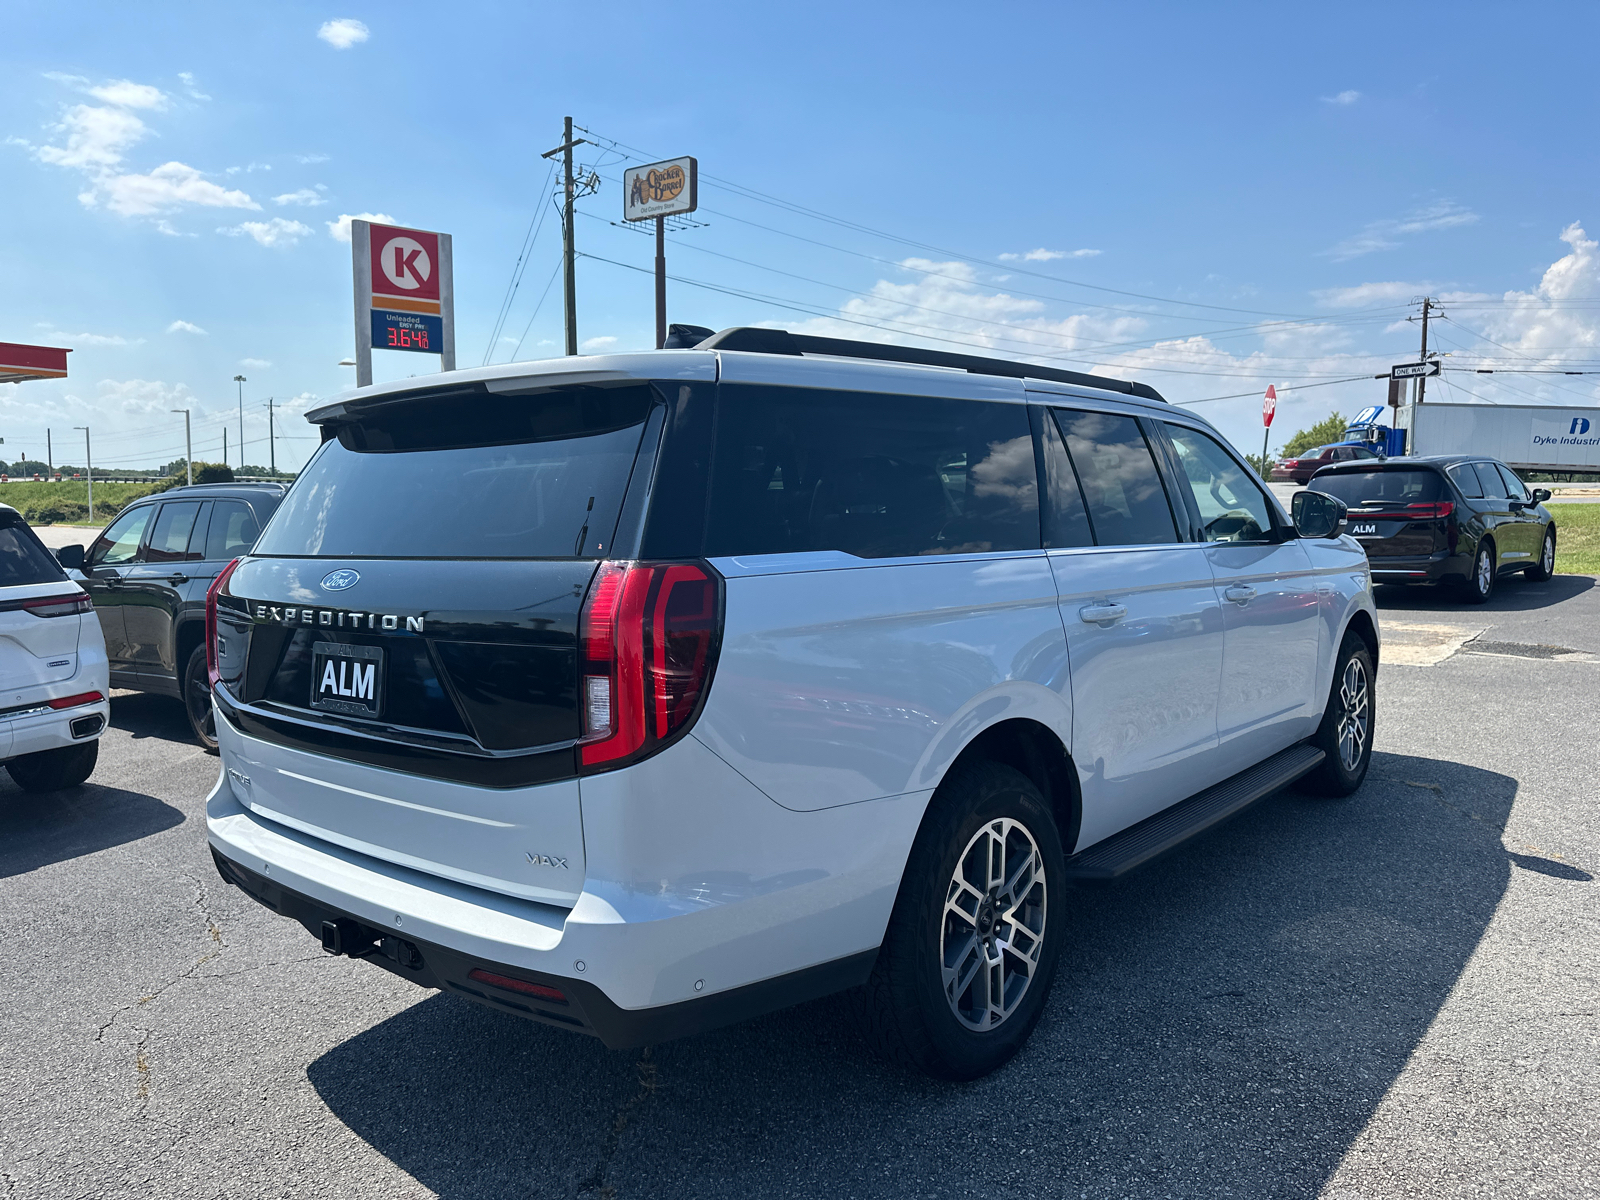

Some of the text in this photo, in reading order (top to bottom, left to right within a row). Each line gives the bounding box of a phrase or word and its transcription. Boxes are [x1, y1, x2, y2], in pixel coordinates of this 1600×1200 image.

[647, 170, 680, 188] Cracker
[654, 178, 682, 200] Barrel
[394, 246, 427, 288] K
[386, 314, 420, 324] Unleaded
[1396, 368, 1410, 376] ONE
[1263, 397, 1276, 414] STOP
[1533, 435, 1557, 446] Dyke
[1352, 524, 1376, 534] ALM
[256, 605, 425, 632] EXPEDITION
[319, 659, 375, 700] ALM
[525, 851, 569, 869] MAX
